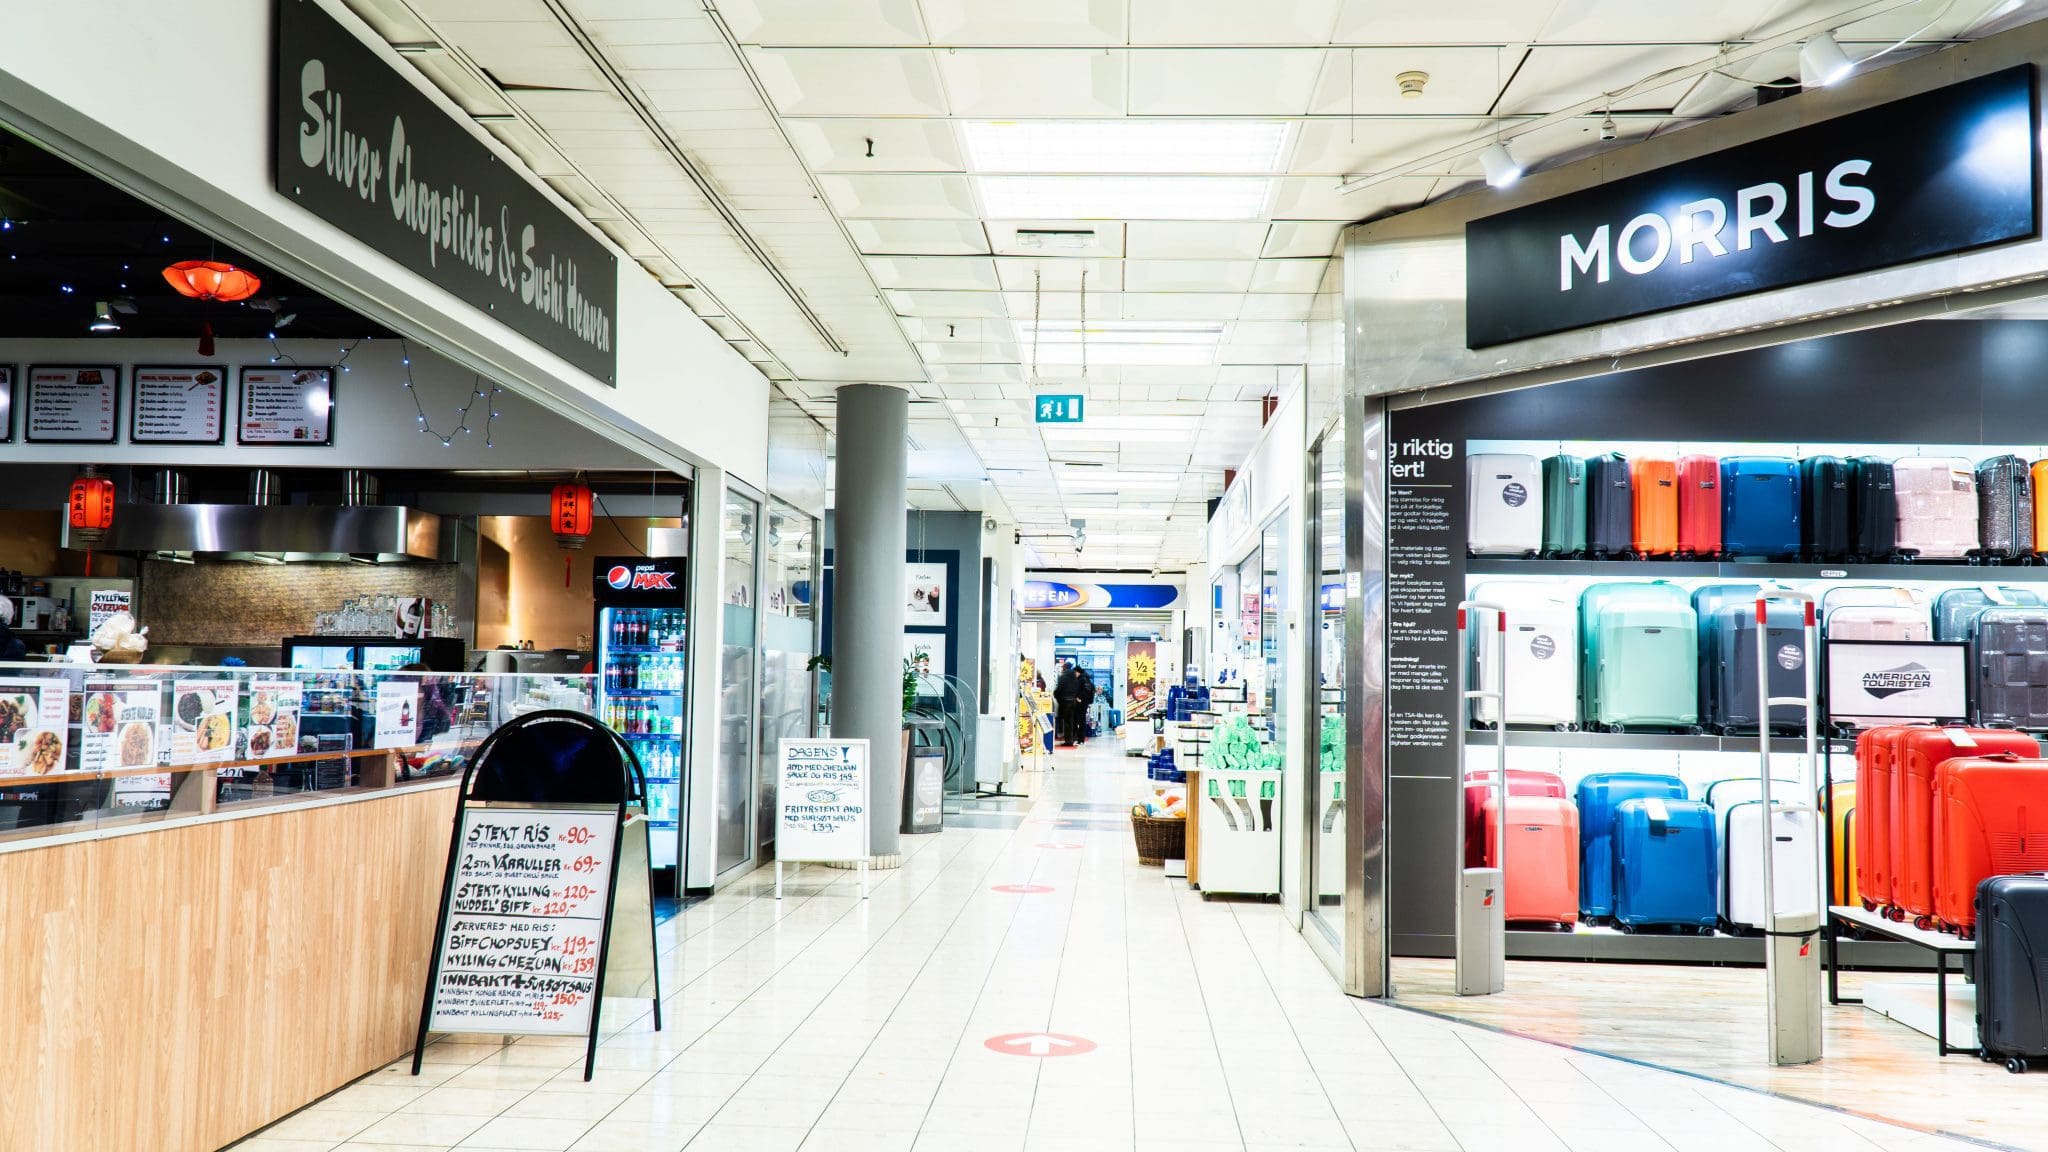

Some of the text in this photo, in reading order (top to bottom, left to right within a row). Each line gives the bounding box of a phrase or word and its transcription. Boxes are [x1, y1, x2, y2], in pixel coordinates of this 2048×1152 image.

[301, 59, 609, 352] Silver Chopsticks & Sushi Heaven
[1560, 159, 1876, 292] MORRIS
[1403, 439, 1453, 459] riktig
[632, 572, 675, 589] MAX
[95, 594, 128, 602] KYLLING
[1024, 590, 1068, 601] ESEN
[789, 747, 837, 757] DAGENS
[468, 823, 520, 842] STEKT
[503, 884, 550, 898] KYLLING
[500, 900, 532, 913] BIFF
[452, 921, 507, 932] SERVERES
[510, 923, 530, 932] MED
[447, 954, 497, 967] KYLLING
[500, 955, 563, 973] CHEZUAN
[552, 993, 584, 1006] 150,-
